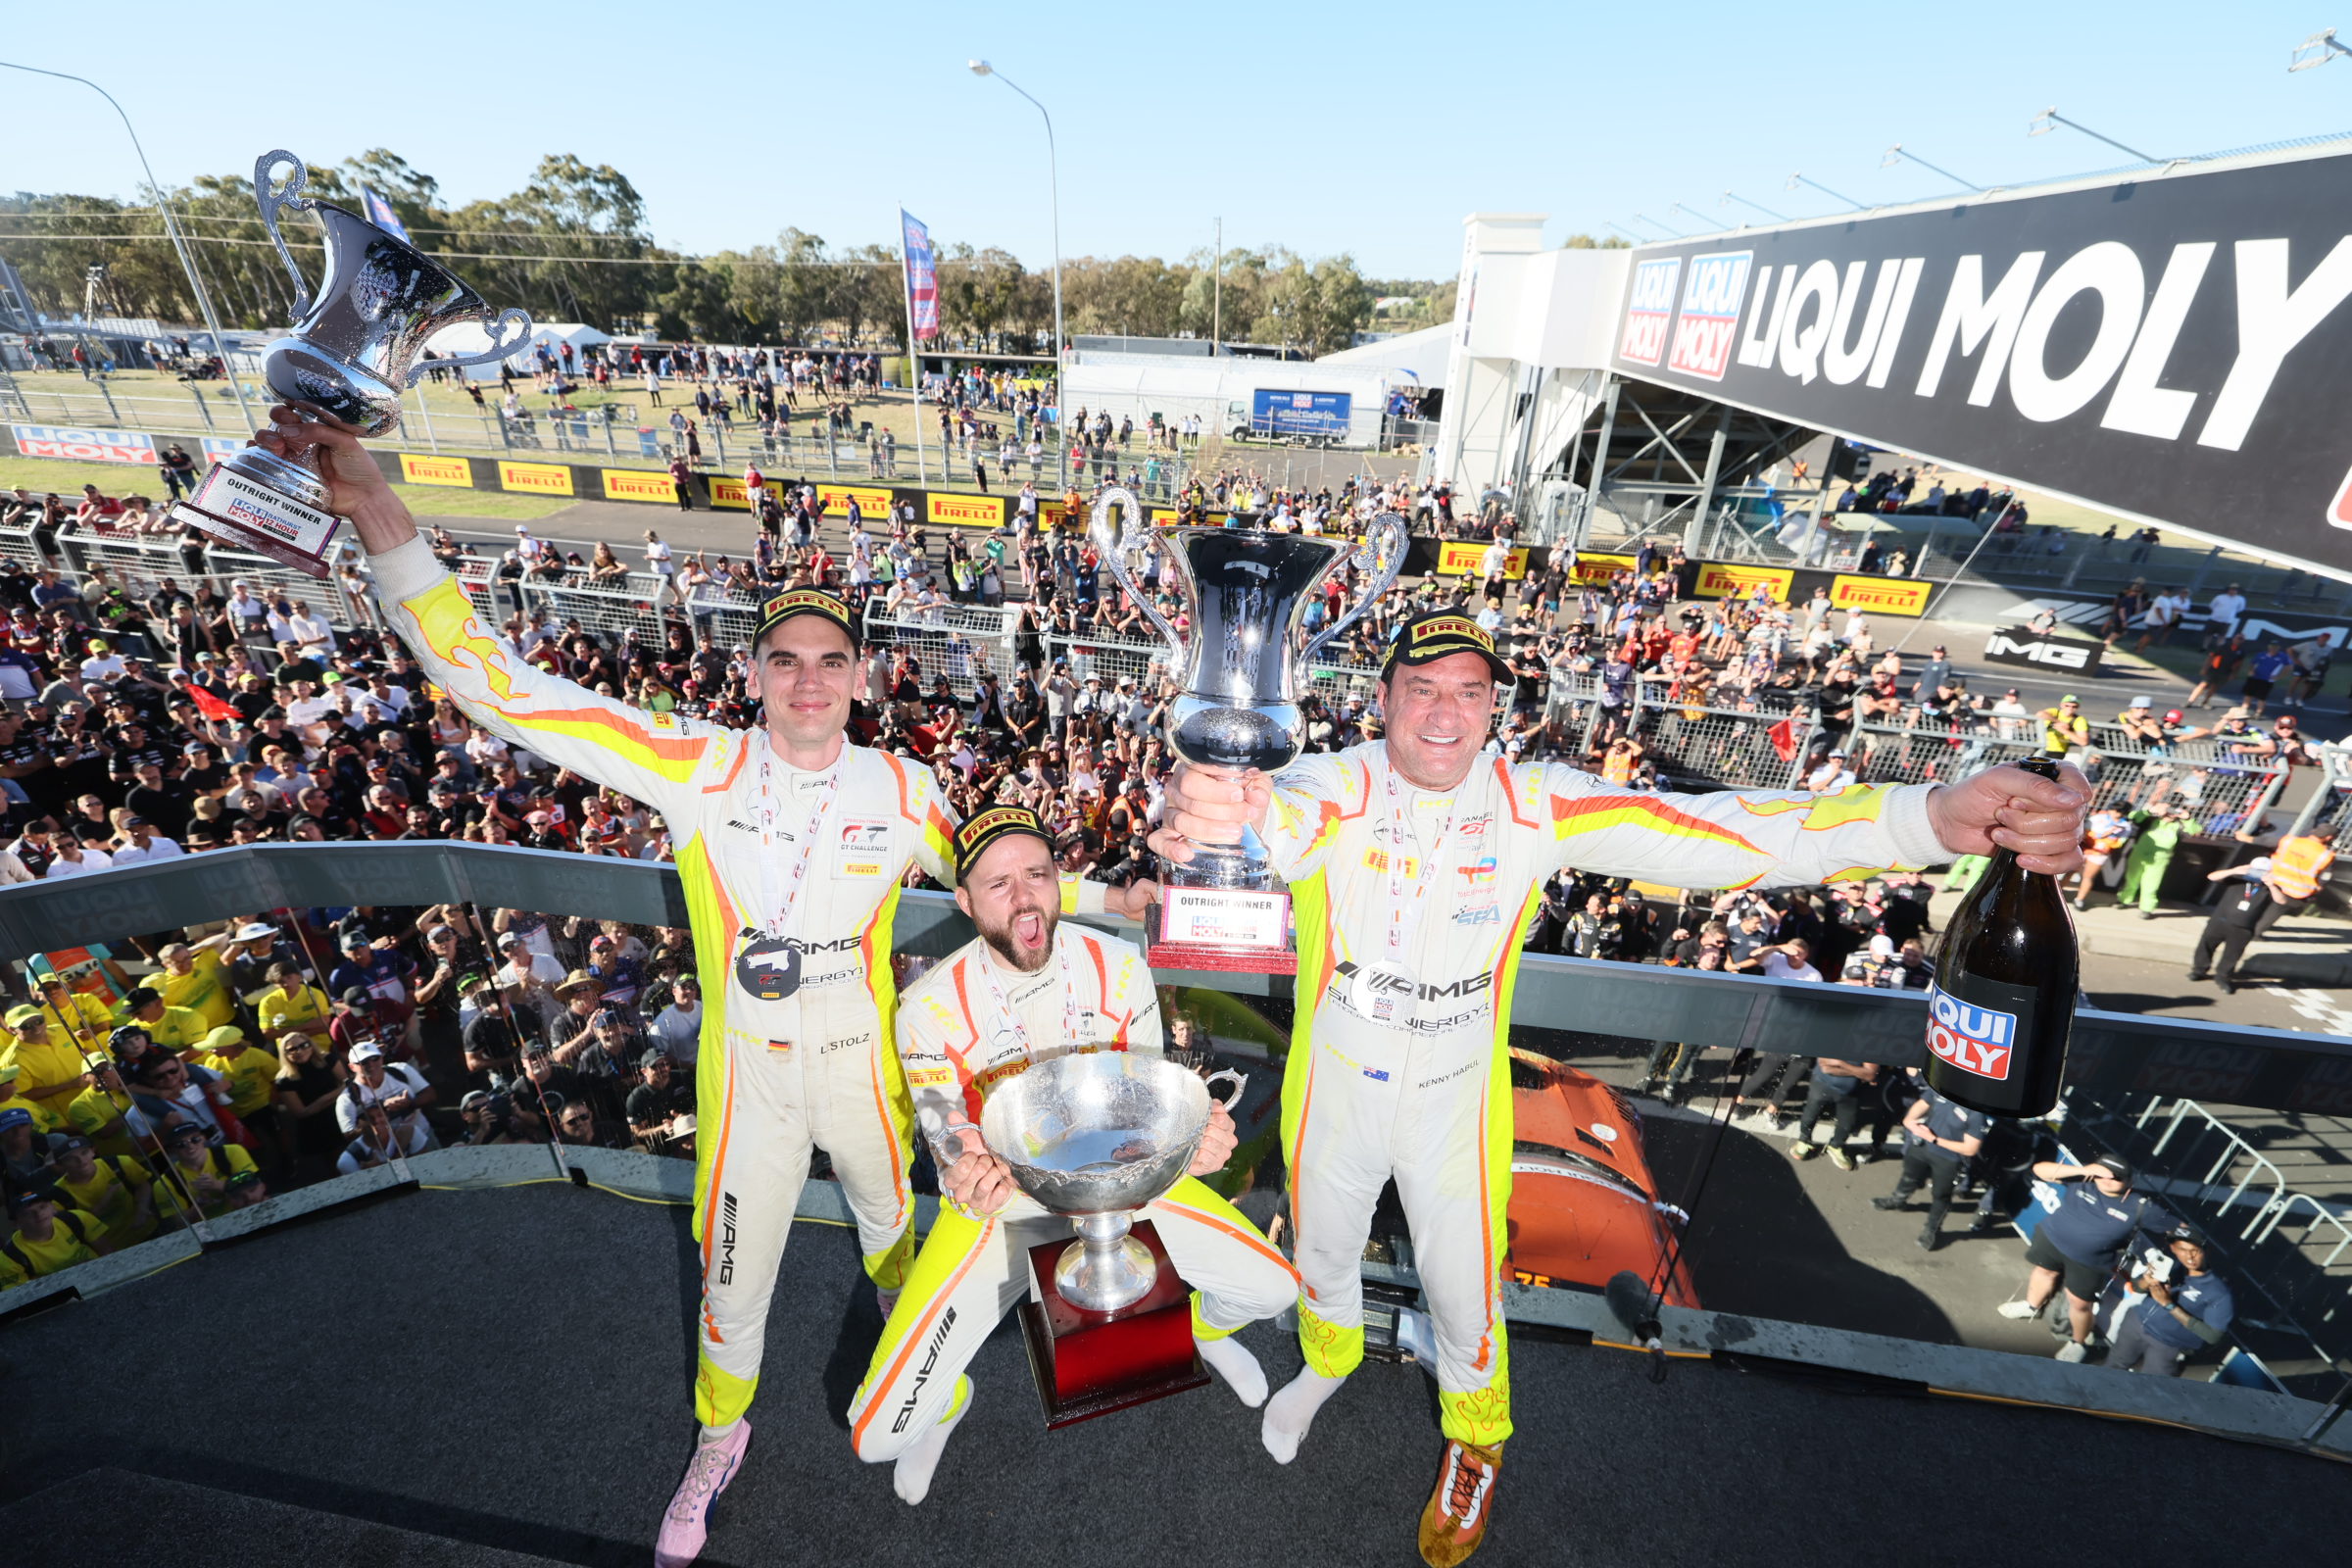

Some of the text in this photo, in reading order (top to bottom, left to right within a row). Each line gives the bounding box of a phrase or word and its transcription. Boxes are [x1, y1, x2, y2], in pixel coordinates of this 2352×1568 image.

[1633, 264, 1678, 310] LIQUI
[1684, 259, 1748, 314] LIQUI
[1622, 314, 1668, 362] MOLY
[1670, 319, 1735, 372] MOLY
[1738, 235, 2352, 451] LIQUI MOLY
[20, 426, 147, 448] LIQUI
[24, 441, 152, 462] MOLY
[409, 462, 465, 479] PIRELLI
[507, 468, 564, 488] PIRELLI
[610, 477, 670, 496] PIRELLI
[227, 478, 321, 525] OUTRIGHT WINNER
[234, 498, 268, 518] LIQUI
[934, 501, 997, 520] PIRELLI
[228, 507, 265, 526] MOLY
[274, 523, 299, 536] HOUR
[769, 593, 844, 615] PIRELLI
[1840, 584, 1920, 607] PIRELLI
[1417, 618, 1491, 647] PIRELLI
[963, 810, 1032, 844] PIRELLI
[1181, 897, 1272, 910] OUTRIGHT WINNER
[1025, 977, 1055, 999] AMG
[1929, 987, 2007, 1045] IQUI
[907, 1053, 948, 1061] AMG
[1418, 1059, 1480, 1089] KENNY HABUL
[720, 1222, 736, 1286] AMG
[1515, 1271, 1550, 1289] 75
[891, 1344, 938, 1434] AMG
